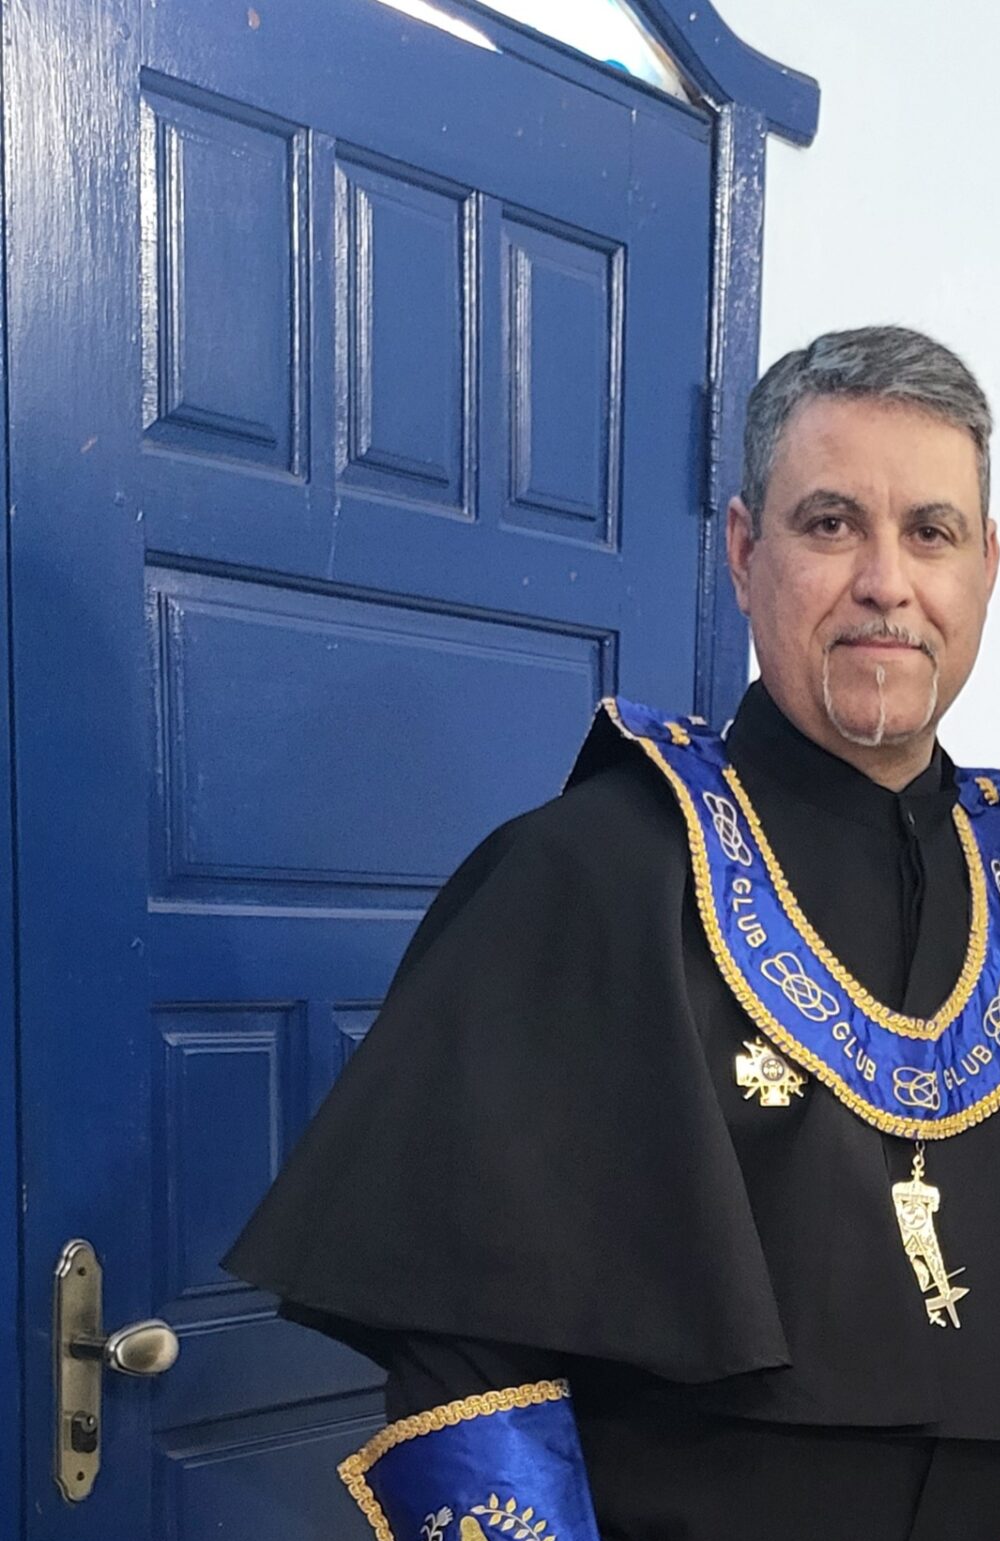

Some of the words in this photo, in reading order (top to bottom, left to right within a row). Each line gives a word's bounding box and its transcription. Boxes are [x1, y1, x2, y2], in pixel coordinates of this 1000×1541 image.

[732, 878, 767, 948] GLUB
[832, 1022, 876, 1081] GLUB
[943, 1044, 993, 1090] GLUB
